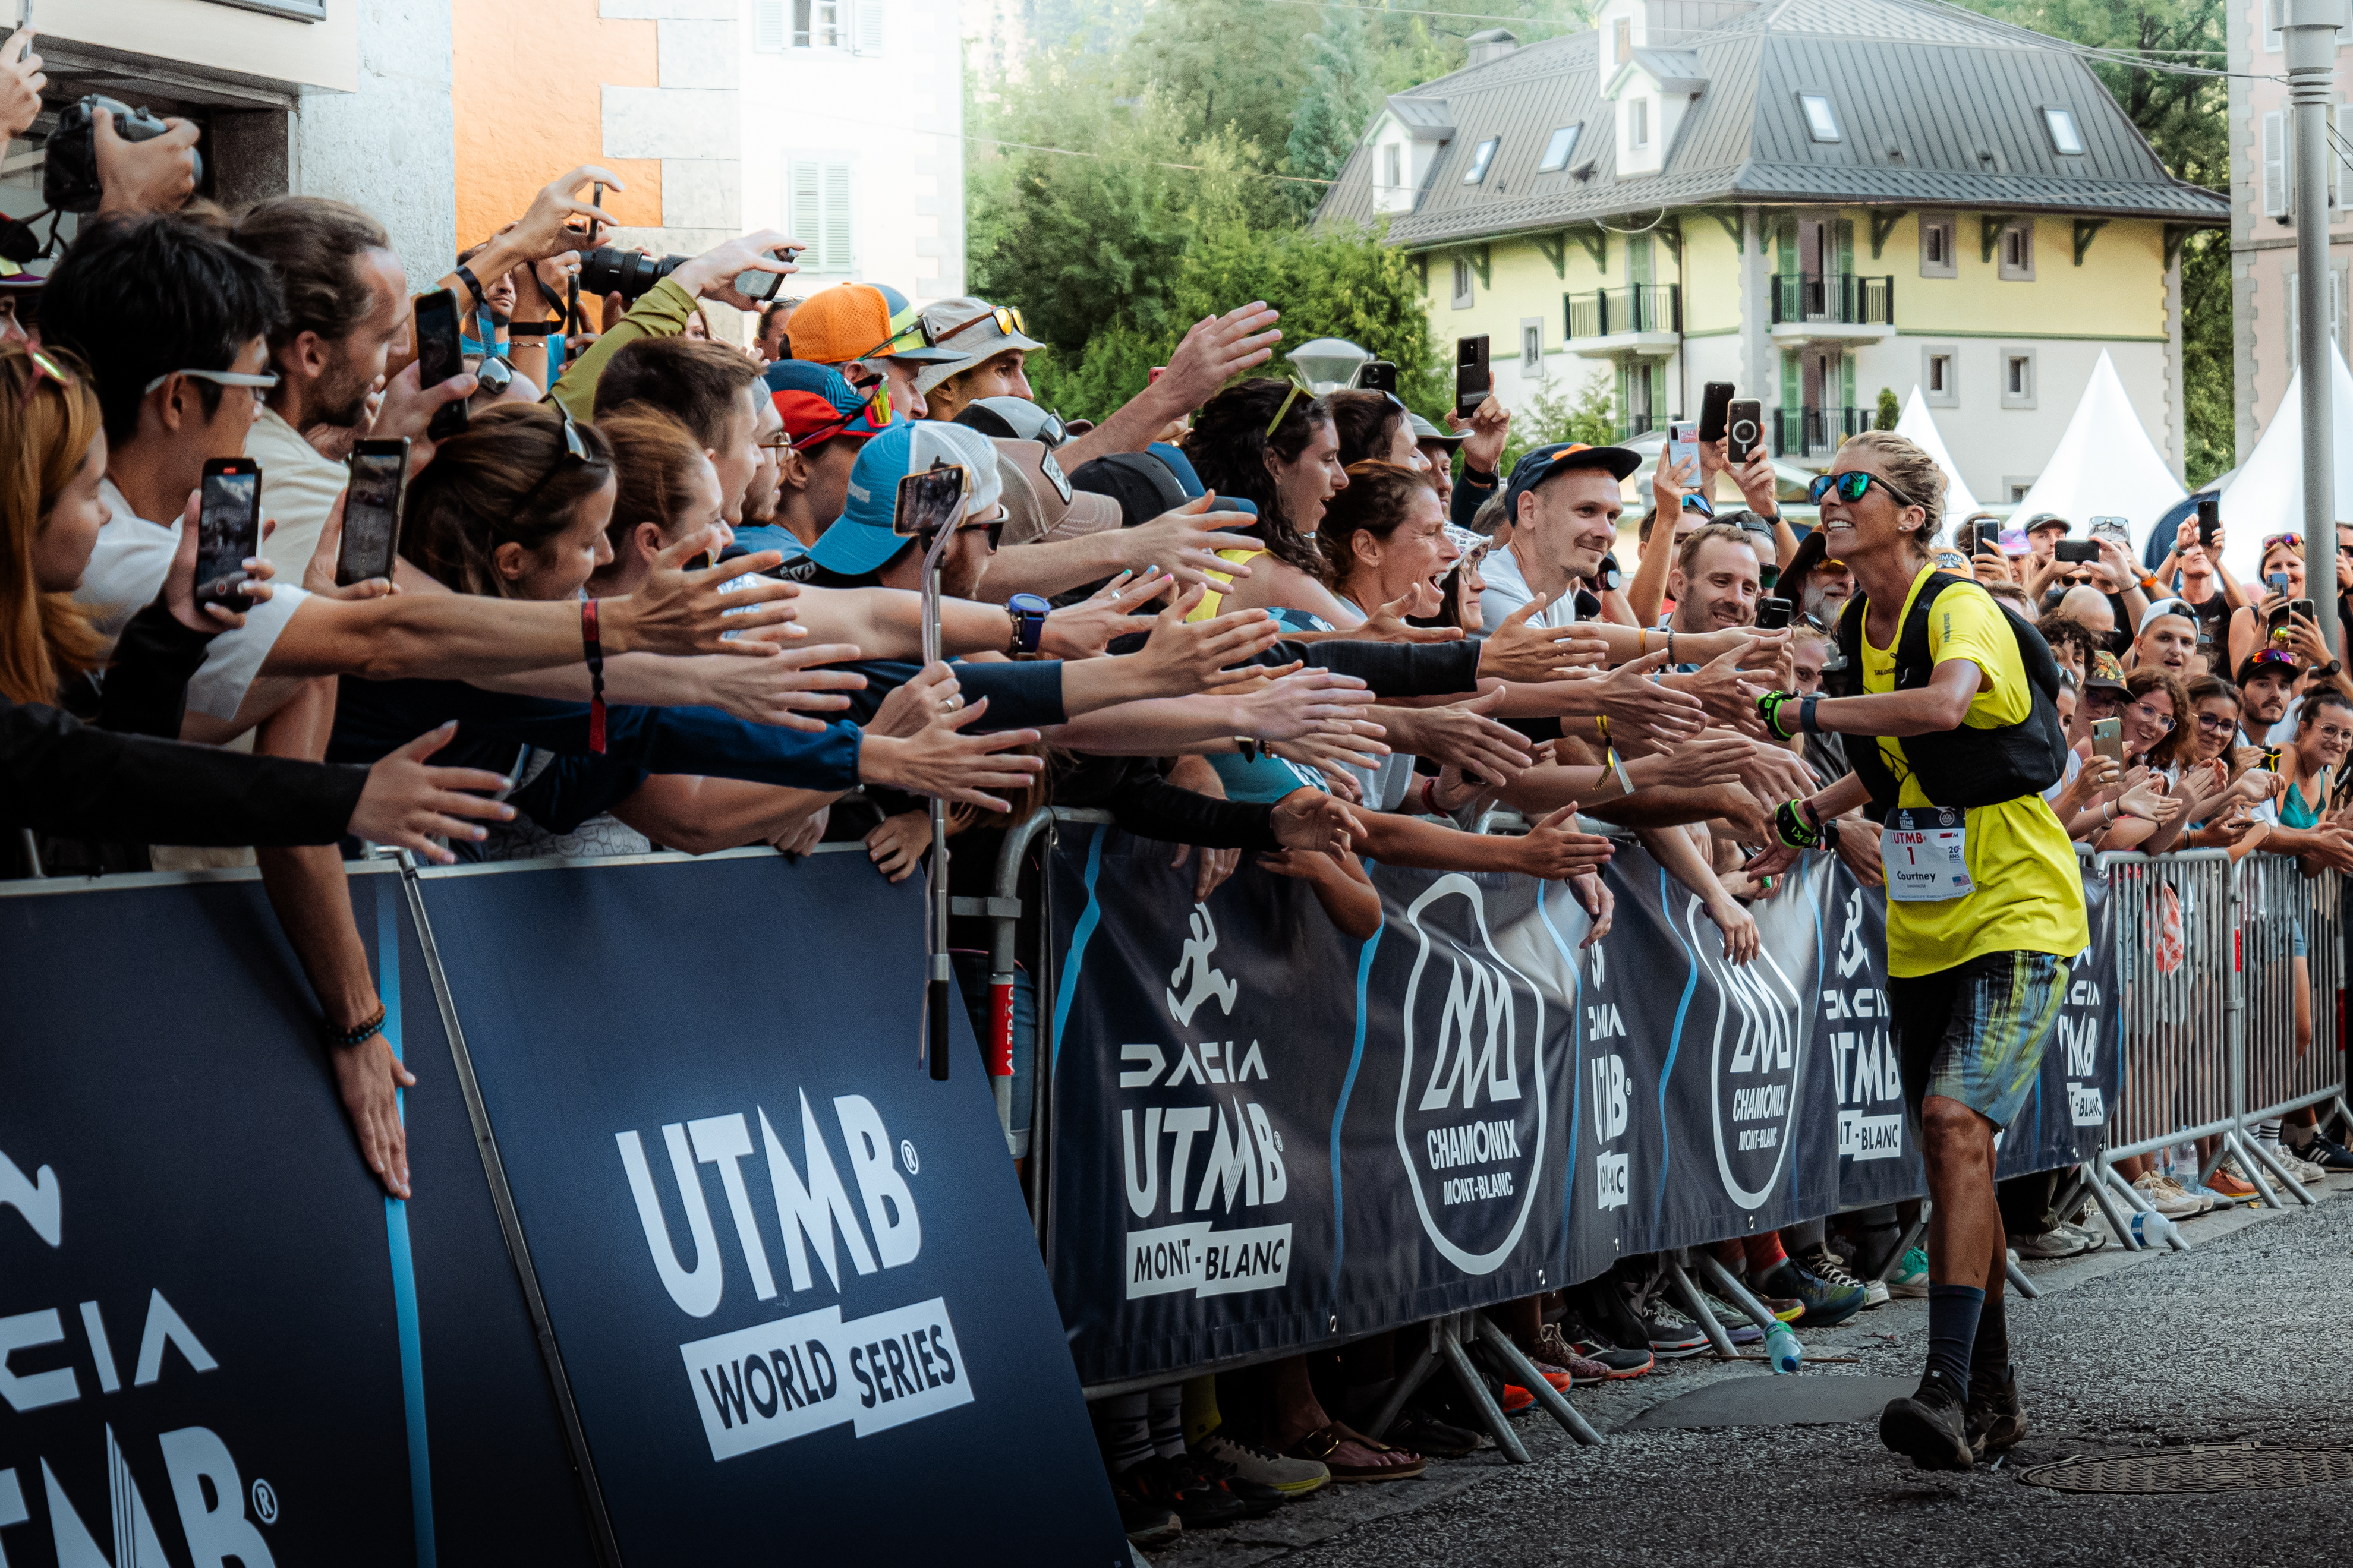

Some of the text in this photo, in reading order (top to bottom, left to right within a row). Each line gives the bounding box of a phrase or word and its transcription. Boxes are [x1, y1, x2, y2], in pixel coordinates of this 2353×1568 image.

[1897, 871, 1936, 882] Courtney
[1907, 847, 1915, 865] 1
[1120, 1039, 1268, 1088] DACIA
[1733, 1084, 1786, 1121] CHAMONIX
[1426, 1119, 1520, 1170] CHAMONIX
[1738, 1127, 1777, 1151] MONT-BLANC
[1443, 1171, 1514, 1206] MONT-BLANC
[1134, 1238, 1286, 1283] MONT-BLANC
[0, 1288, 218, 1412] CIA
[700, 1324, 956, 1430] WORLD SERIES
